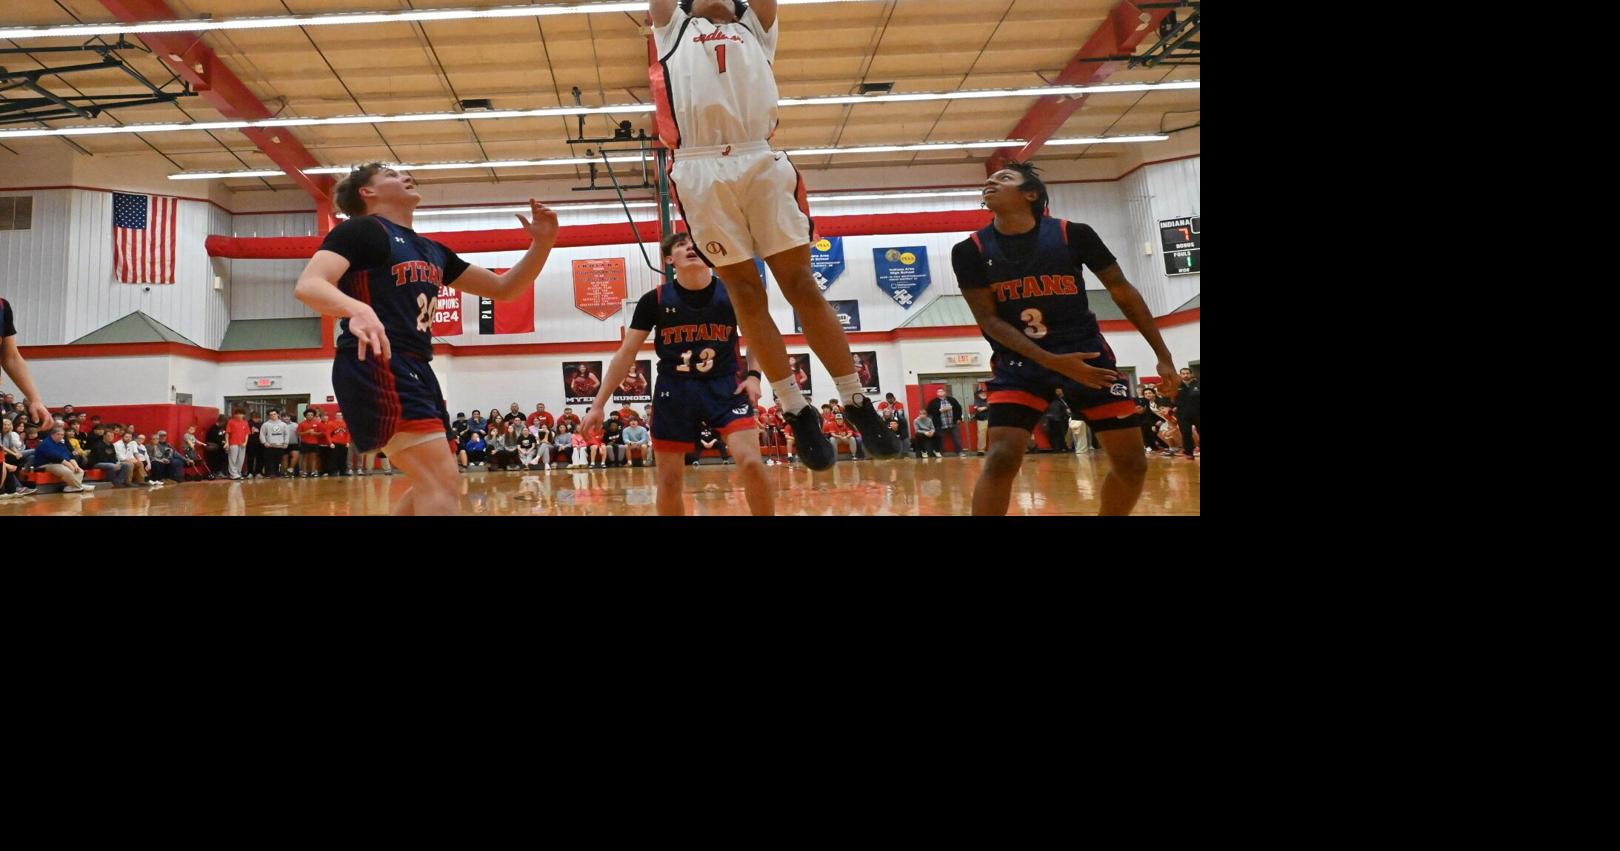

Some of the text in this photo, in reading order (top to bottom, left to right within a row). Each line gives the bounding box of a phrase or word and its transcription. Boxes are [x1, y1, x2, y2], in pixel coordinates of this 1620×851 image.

[714, 44, 727, 74] 1
[1160, 220, 1190, 228] INDIANA
[1178, 228, 1190, 241] 7
[1187, 256, 1191, 267] 1
[433, 310, 460, 323] 024
[1020, 308, 1048, 339] 3
[676, 348, 716, 373] 13
